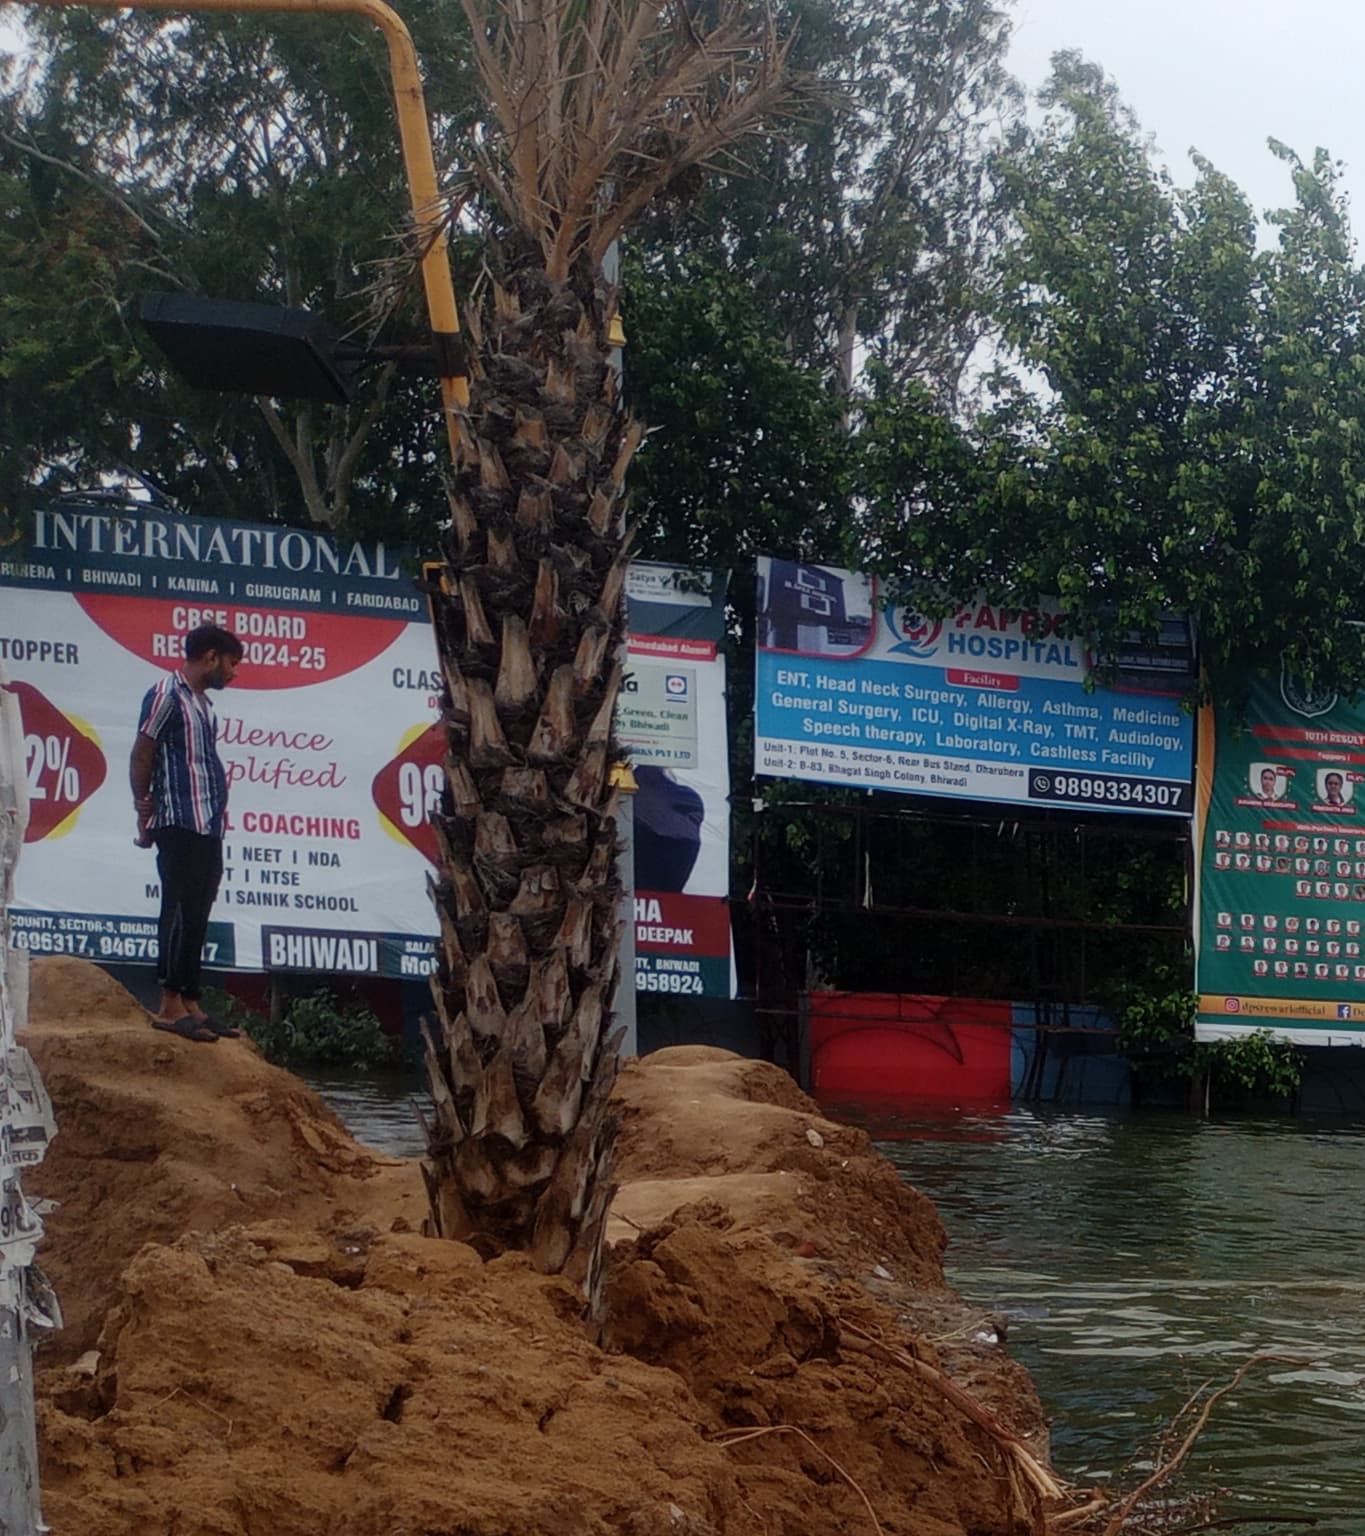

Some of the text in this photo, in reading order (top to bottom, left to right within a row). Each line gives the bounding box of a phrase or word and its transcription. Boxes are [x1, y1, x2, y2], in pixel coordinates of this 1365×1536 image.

[32, 510, 399, 580] INTERNATIONAL
[83, 569, 141, 587] BHIWADI
[168, 577, 218, 594] KANINA
[246, 584, 321, 603] GURUGRAM
[347, 593, 419, 611] FARIDABAD
[235, 609, 306, 640] BOARD
[240, 641, 326, 669] 2024-25
[948, 633, 1078, 667] HOSPITAL
[393, 667, 443, 691] CLAS
[817, 675, 855, 692] Head
[862, 679, 900, 697] Neck
[904, 685, 968, 707] Surgery,
[977, 693, 1033, 715] Allergy,
[1113, 707, 1180, 728] Medicine
[216, 718, 333, 751] llence
[772, 692, 832, 712] General
[838, 700, 901, 722] Surgery,
[954, 712, 1002, 731] Digital
[1007, 718, 1055, 738] X-Ray,
[1108, 729, 1183, 751] Audiology,
[803, 718, 1155, 770] Speech therapy, Laboratory, Cashless Facility
[24, 734, 80, 802] 2%
[225, 756, 346, 789] plified
[1054, 776, 1182, 806] 9899334307
[243, 811, 361, 840] COACHING
[243, 846, 341, 867] NEET NDA
[261, 869, 300, 886] NTSE
[236, 890, 359, 912] SAINIK SCHOOL
[637, 926, 694, 945] DEEPAK
[270, 933, 378, 972] BHIWADI
[635, 972, 704, 995] 958924
